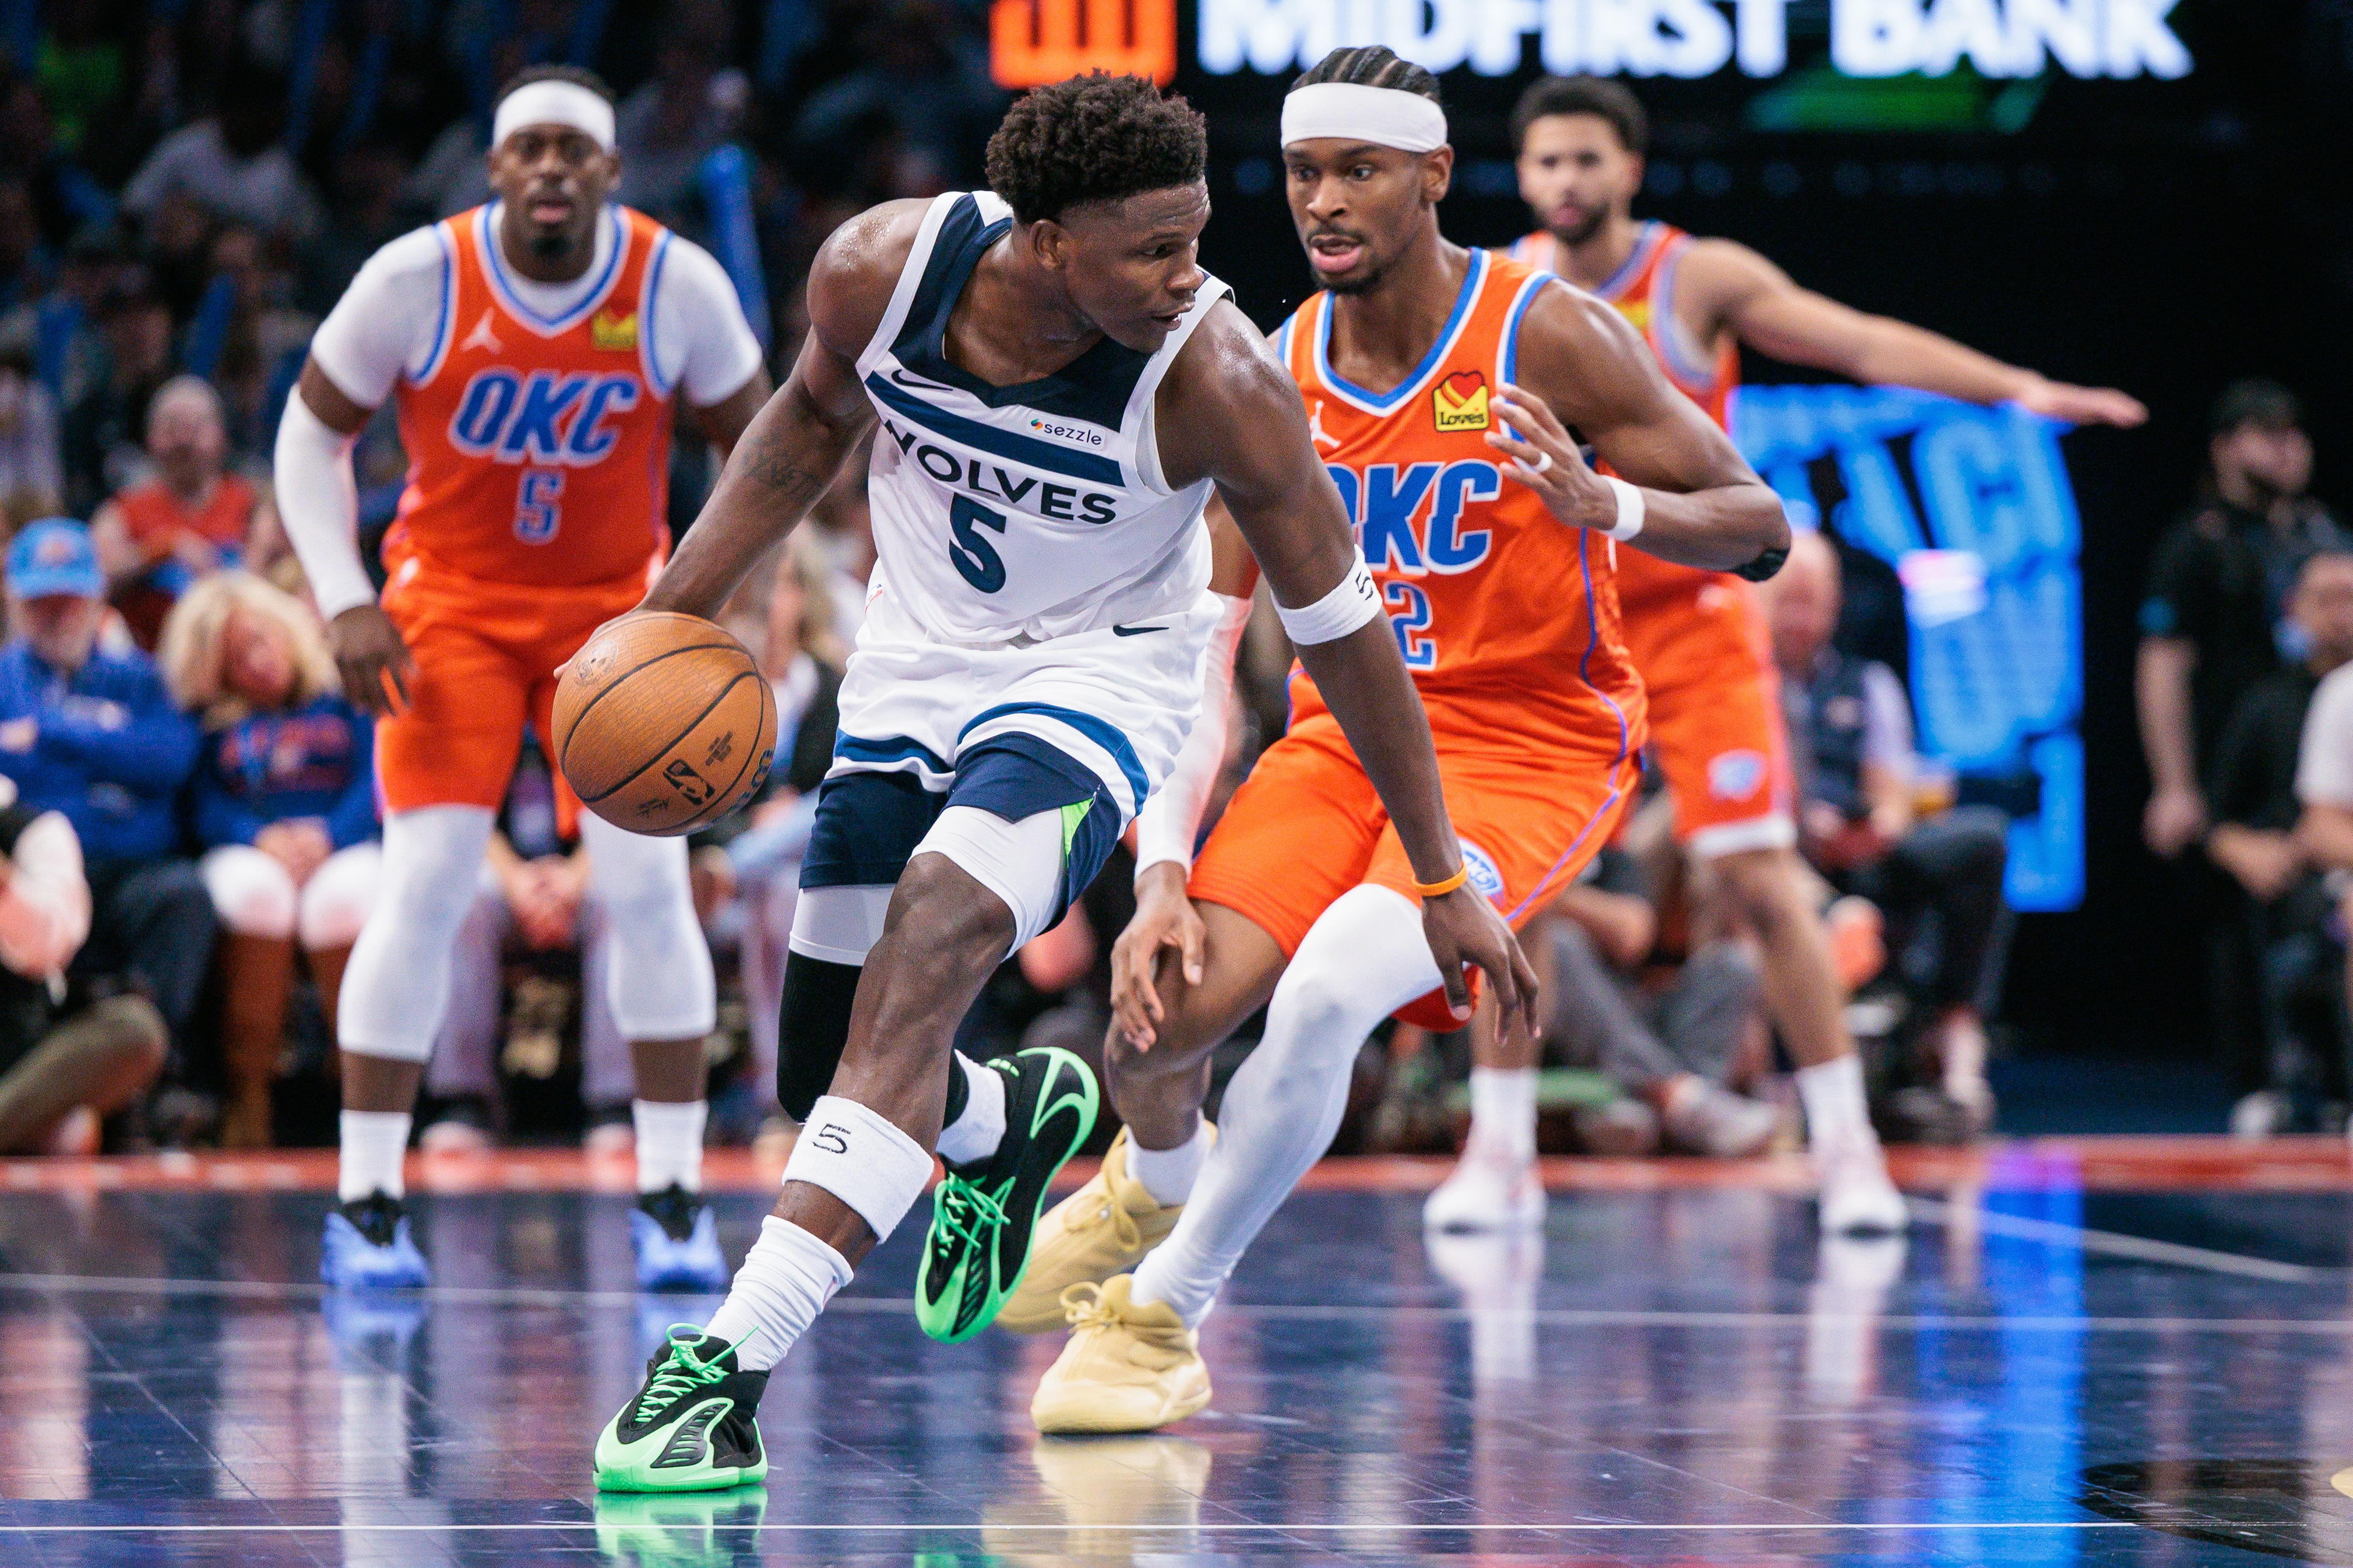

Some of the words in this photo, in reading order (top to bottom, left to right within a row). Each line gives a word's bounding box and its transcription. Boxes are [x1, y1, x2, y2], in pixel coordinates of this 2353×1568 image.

[1829, 0, 2196, 79] BANK
[448, 365, 640, 467] OKC
[1044, 424, 1102, 445] sezzle
[512, 468, 568, 545] 5
[949, 493, 1007, 594] 5
[1383, 580, 1438, 671] 2
[812, 1123, 851, 1154] 5
